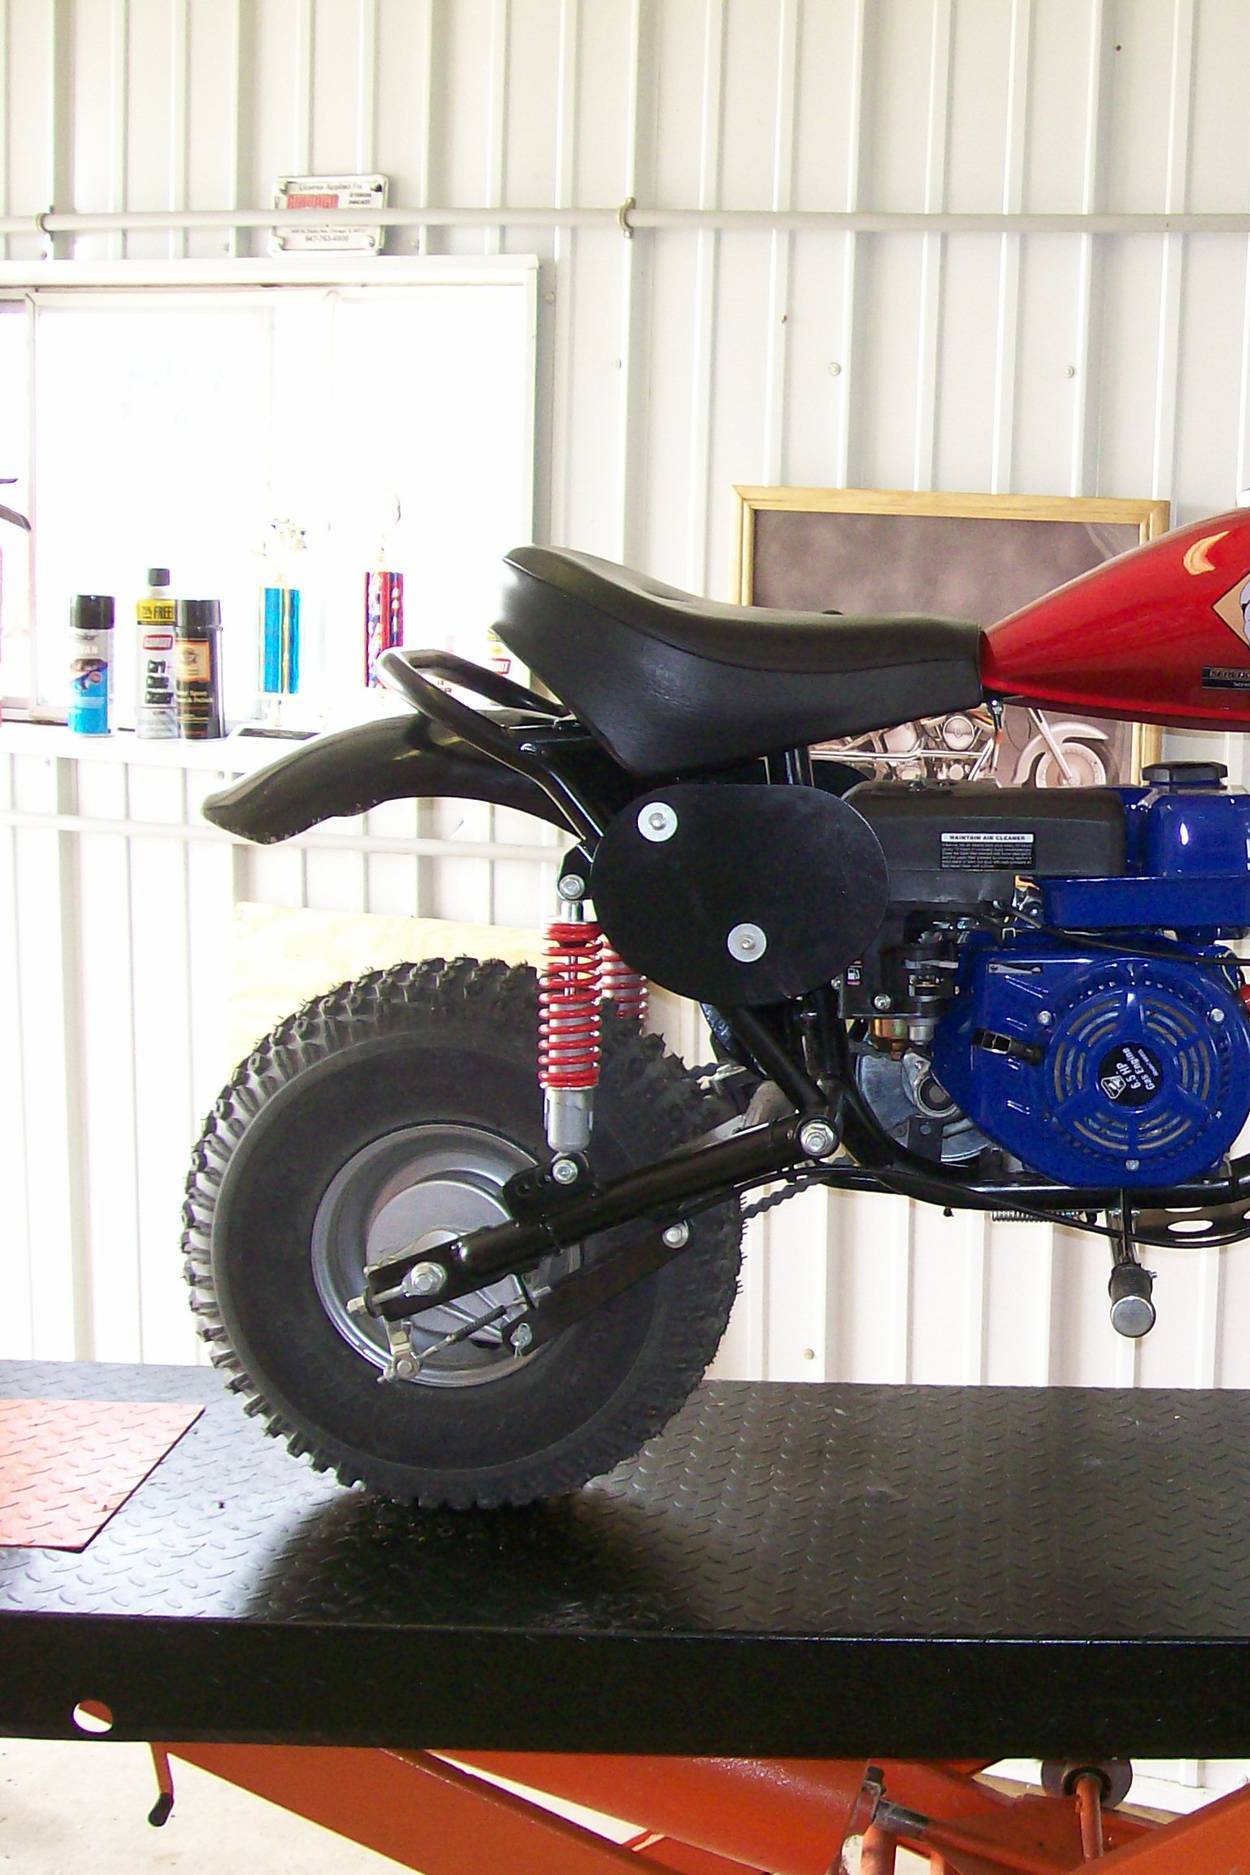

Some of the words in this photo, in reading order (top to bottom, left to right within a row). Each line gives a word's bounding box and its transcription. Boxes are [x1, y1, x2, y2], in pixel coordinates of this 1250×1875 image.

[1116, 1062, 1132, 1076] HP
[1122, 1047, 1145, 1075] Engine
[1126, 1074, 1142, 1090] 6.5
[1141, 1074, 1156, 1091] Gas
